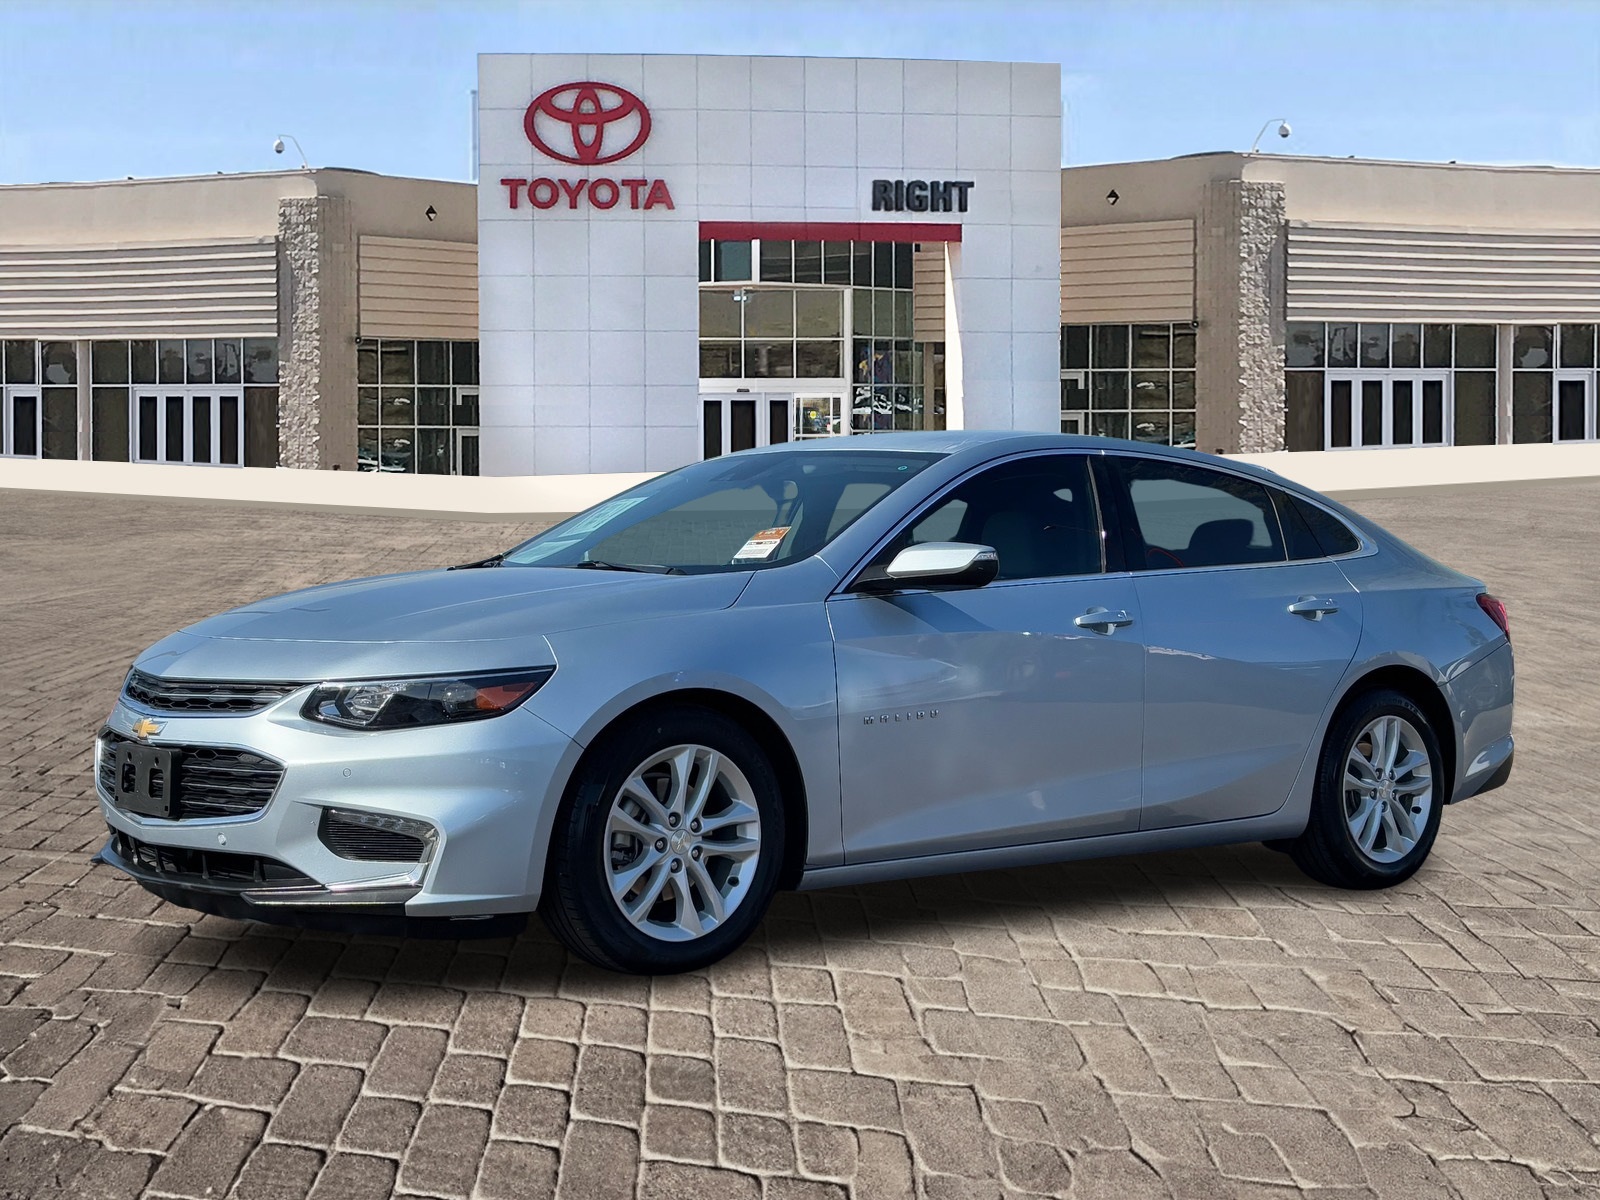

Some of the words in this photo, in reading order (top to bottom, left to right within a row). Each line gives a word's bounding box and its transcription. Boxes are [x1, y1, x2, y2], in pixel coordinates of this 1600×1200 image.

[500, 178, 675, 209] TOYOTA
[872, 180, 974, 212] RIGHT
[864, 709, 939, 725] MALIBU
